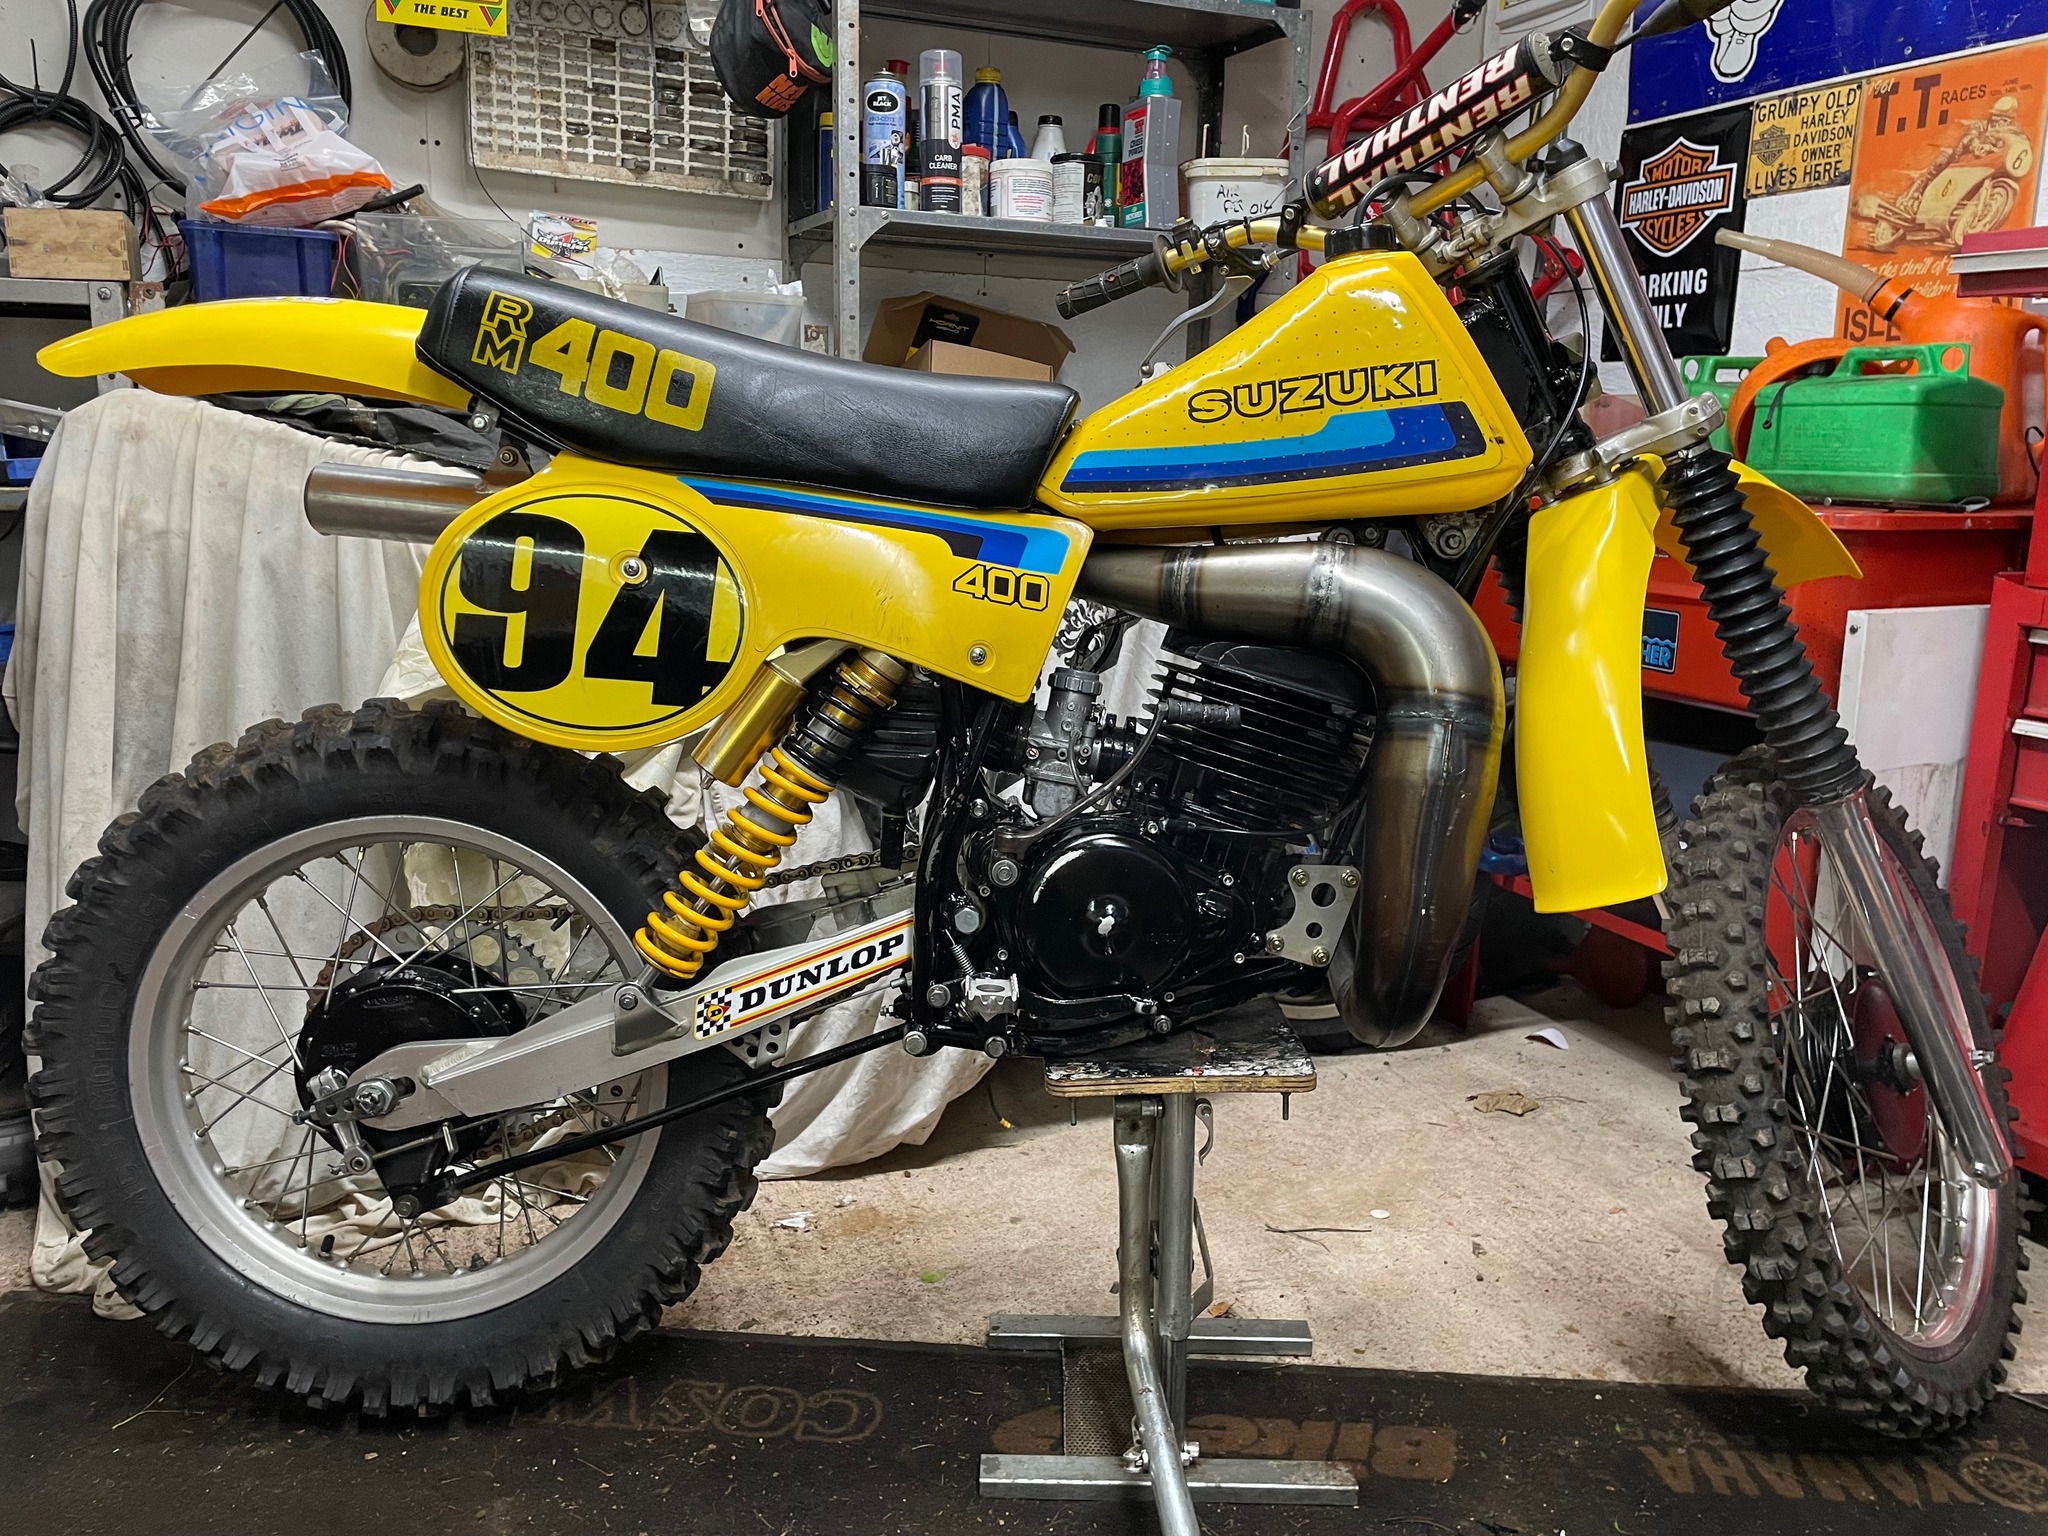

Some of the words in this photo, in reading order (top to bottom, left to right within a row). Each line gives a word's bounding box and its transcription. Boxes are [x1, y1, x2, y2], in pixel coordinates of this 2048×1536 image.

[414, 3, 437, 15] THE
[440, 6, 469, 19] BEST
[951, 93, 961, 130] PMA
[1317, 42, 1521, 186] RENTHAL
[1757, 94, 1820, 123] GRUMPY
[1825, 88, 1857, 110] OLD
[1800, 108, 1850, 130] HARLEY
[1872, 73, 1949, 136] T.T.
[1940, 84, 1987, 106] RACES
[1328, 72, 1532, 206] RENTHAL
[1793, 124, 1854, 148] DAVIDSON
[928, 162, 958, 170] CLEANER
[1651, 152, 1704, 182] MOTOR
[1801, 143, 1841, 163] OWNER
[2012, 150, 2028, 170] 6
[1755, 167, 1797, 190] LIVES
[1802, 160, 1842, 183] HERE
[1628, 177, 1724, 216] HARLEY-DAVIDSON
[1646, 211, 1697, 244] CYCLES
[1879, 260, 1899, 277] the
[1899, 256, 1934, 277] thrill
[1931, 254, 1948, 277] of
[1639, 267, 1709, 299] ARKING
[1653, 302, 1688, 329] NLY
[471, 290, 534, 375] RM
[528, 317, 717, 432] 400
[1187, 359, 1438, 424] SUZUKI
[952, 563, 1050, 612] 400
[451, 511, 732, 708] 94
[1641, 643, 1671, 668] HER
[738, 933, 904, 1013] DUNLOP
[1640, 1444, 1984, 1506] YAMAHA
